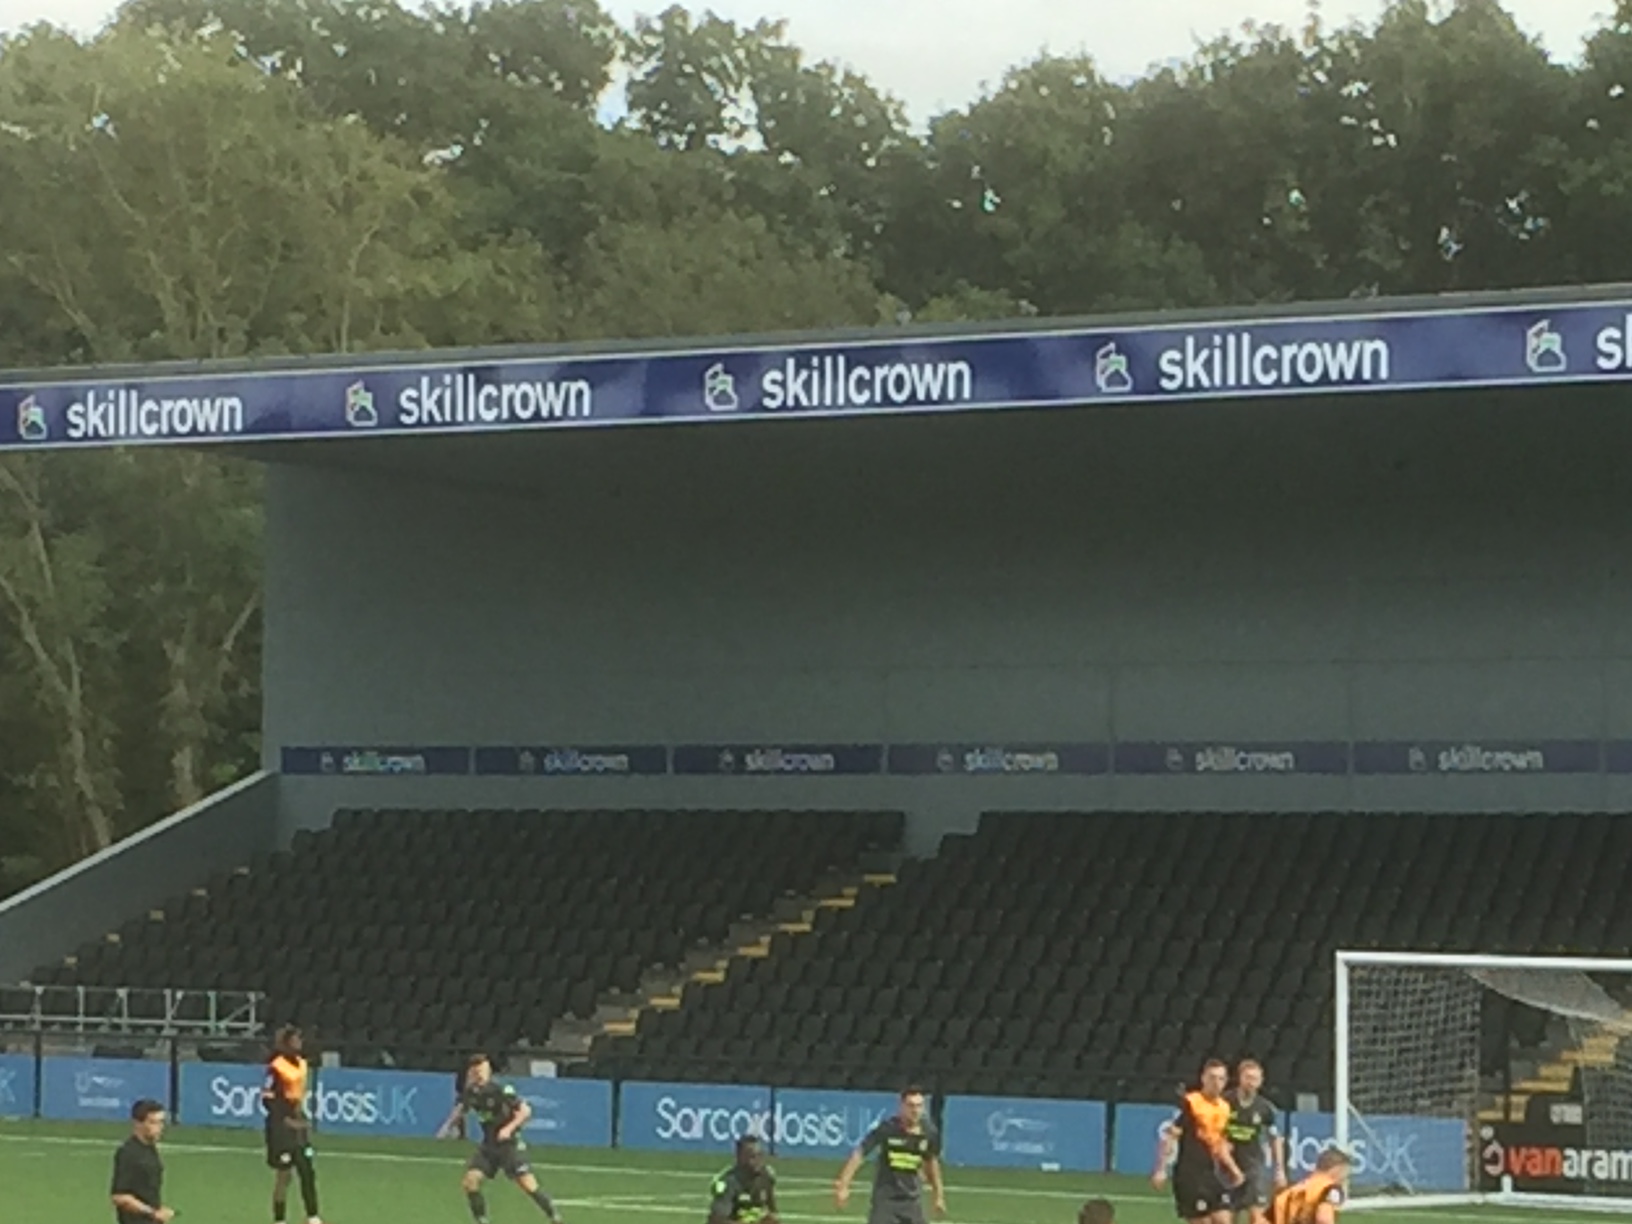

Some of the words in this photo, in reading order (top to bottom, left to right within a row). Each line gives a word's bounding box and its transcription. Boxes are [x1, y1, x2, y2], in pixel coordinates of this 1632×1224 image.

[762, 355, 973, 409] skillcrown
[1158, 334, 1390, 391] skillcrown
[66, 391, 244, 438] skillcrown
[400, 375, 593, 426] skillcrown
